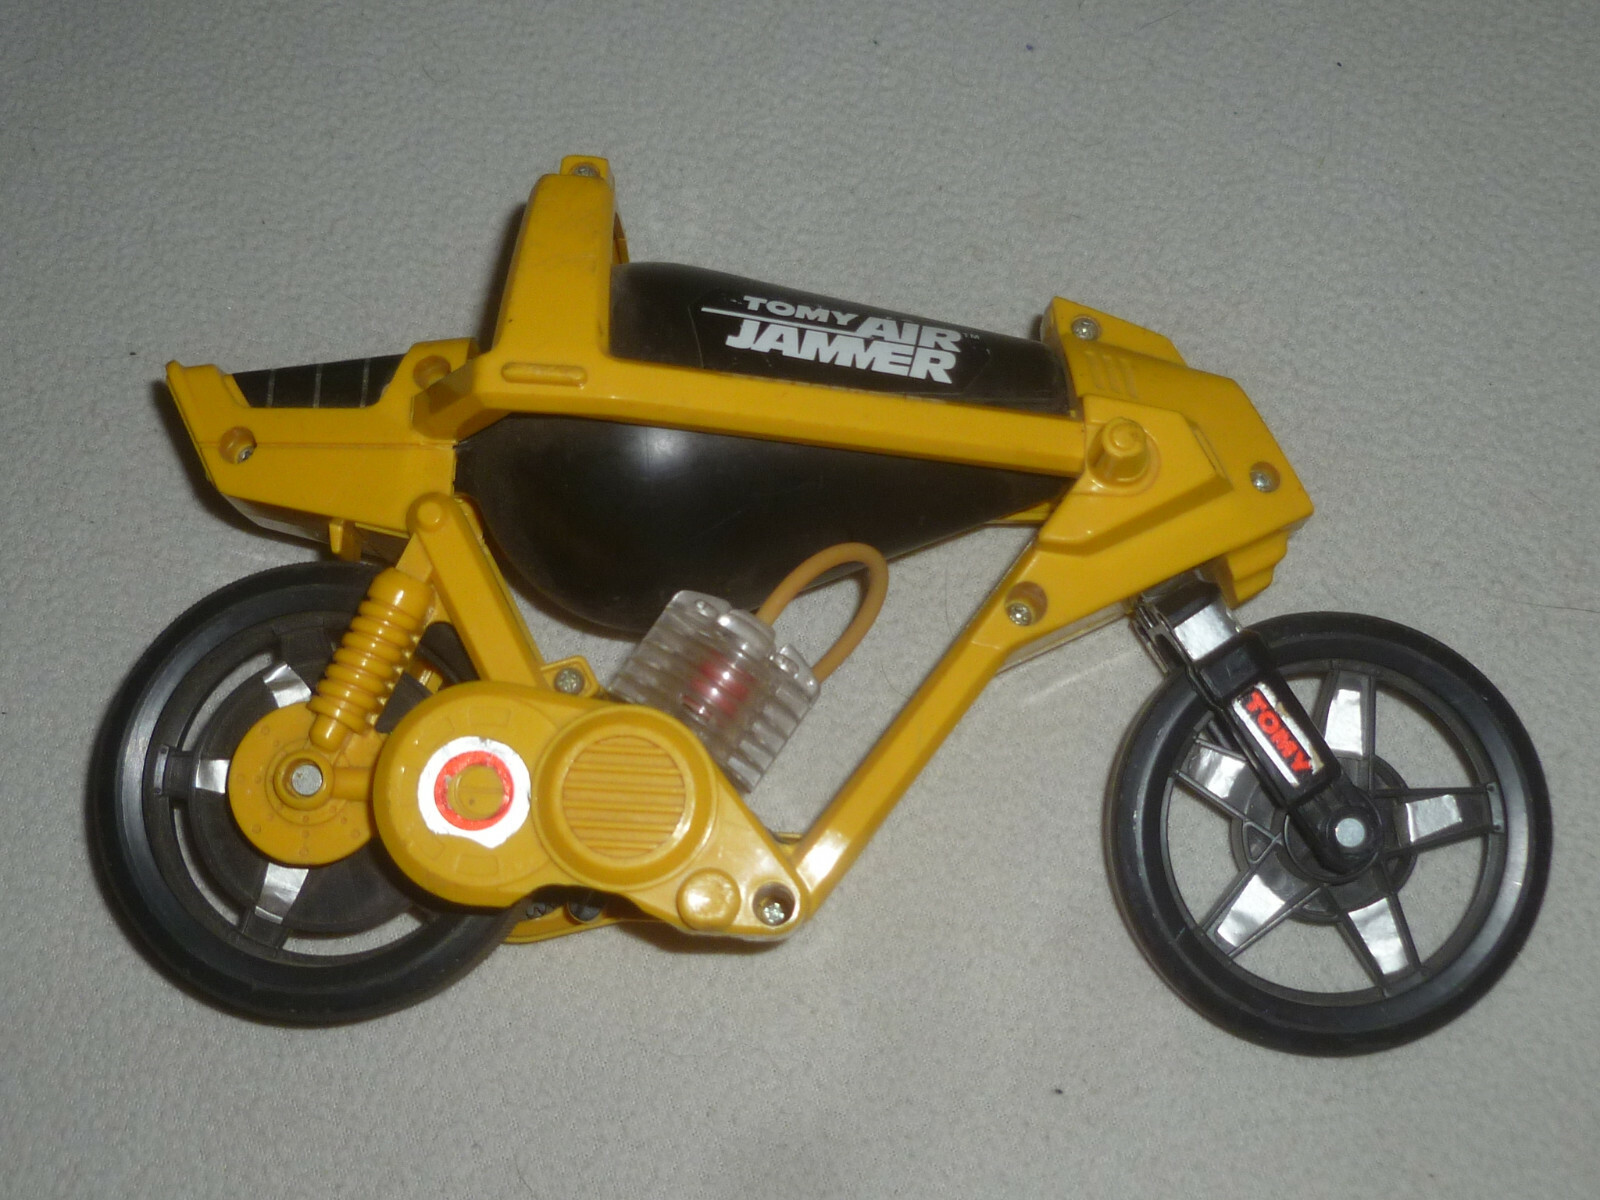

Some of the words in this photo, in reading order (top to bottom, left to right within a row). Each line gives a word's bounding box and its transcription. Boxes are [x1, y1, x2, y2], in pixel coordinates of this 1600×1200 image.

[725, 319, 957, 384] JAMMER
[743, 295, 858, 326] TOMY
[854, 316, 962, 353] AIR
[1246, 690, 1313, 772] TOMY
